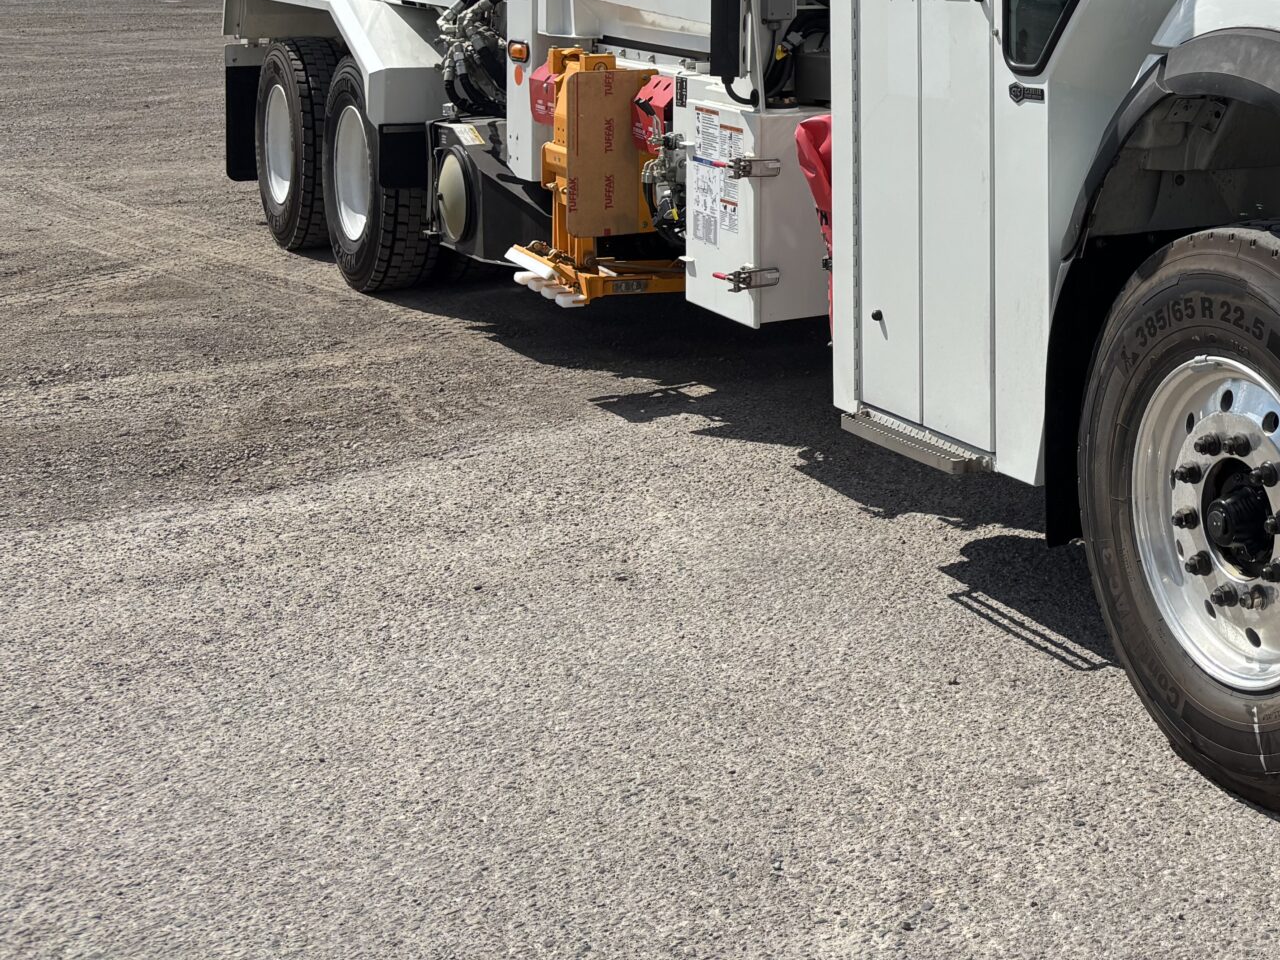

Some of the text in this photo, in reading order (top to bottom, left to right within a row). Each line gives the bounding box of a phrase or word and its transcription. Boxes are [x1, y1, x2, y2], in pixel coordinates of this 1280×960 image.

[605, 119, 613, 154] TUFFAK
[568, 177, 577, 213] TUFFAK
[605, 174, 613, 210] TUFFAK
[1135, 297, 1196, 347] 385/65
[1200, 296, 1214, 319] R
[1220, 301, 1265, 341] 22.5
